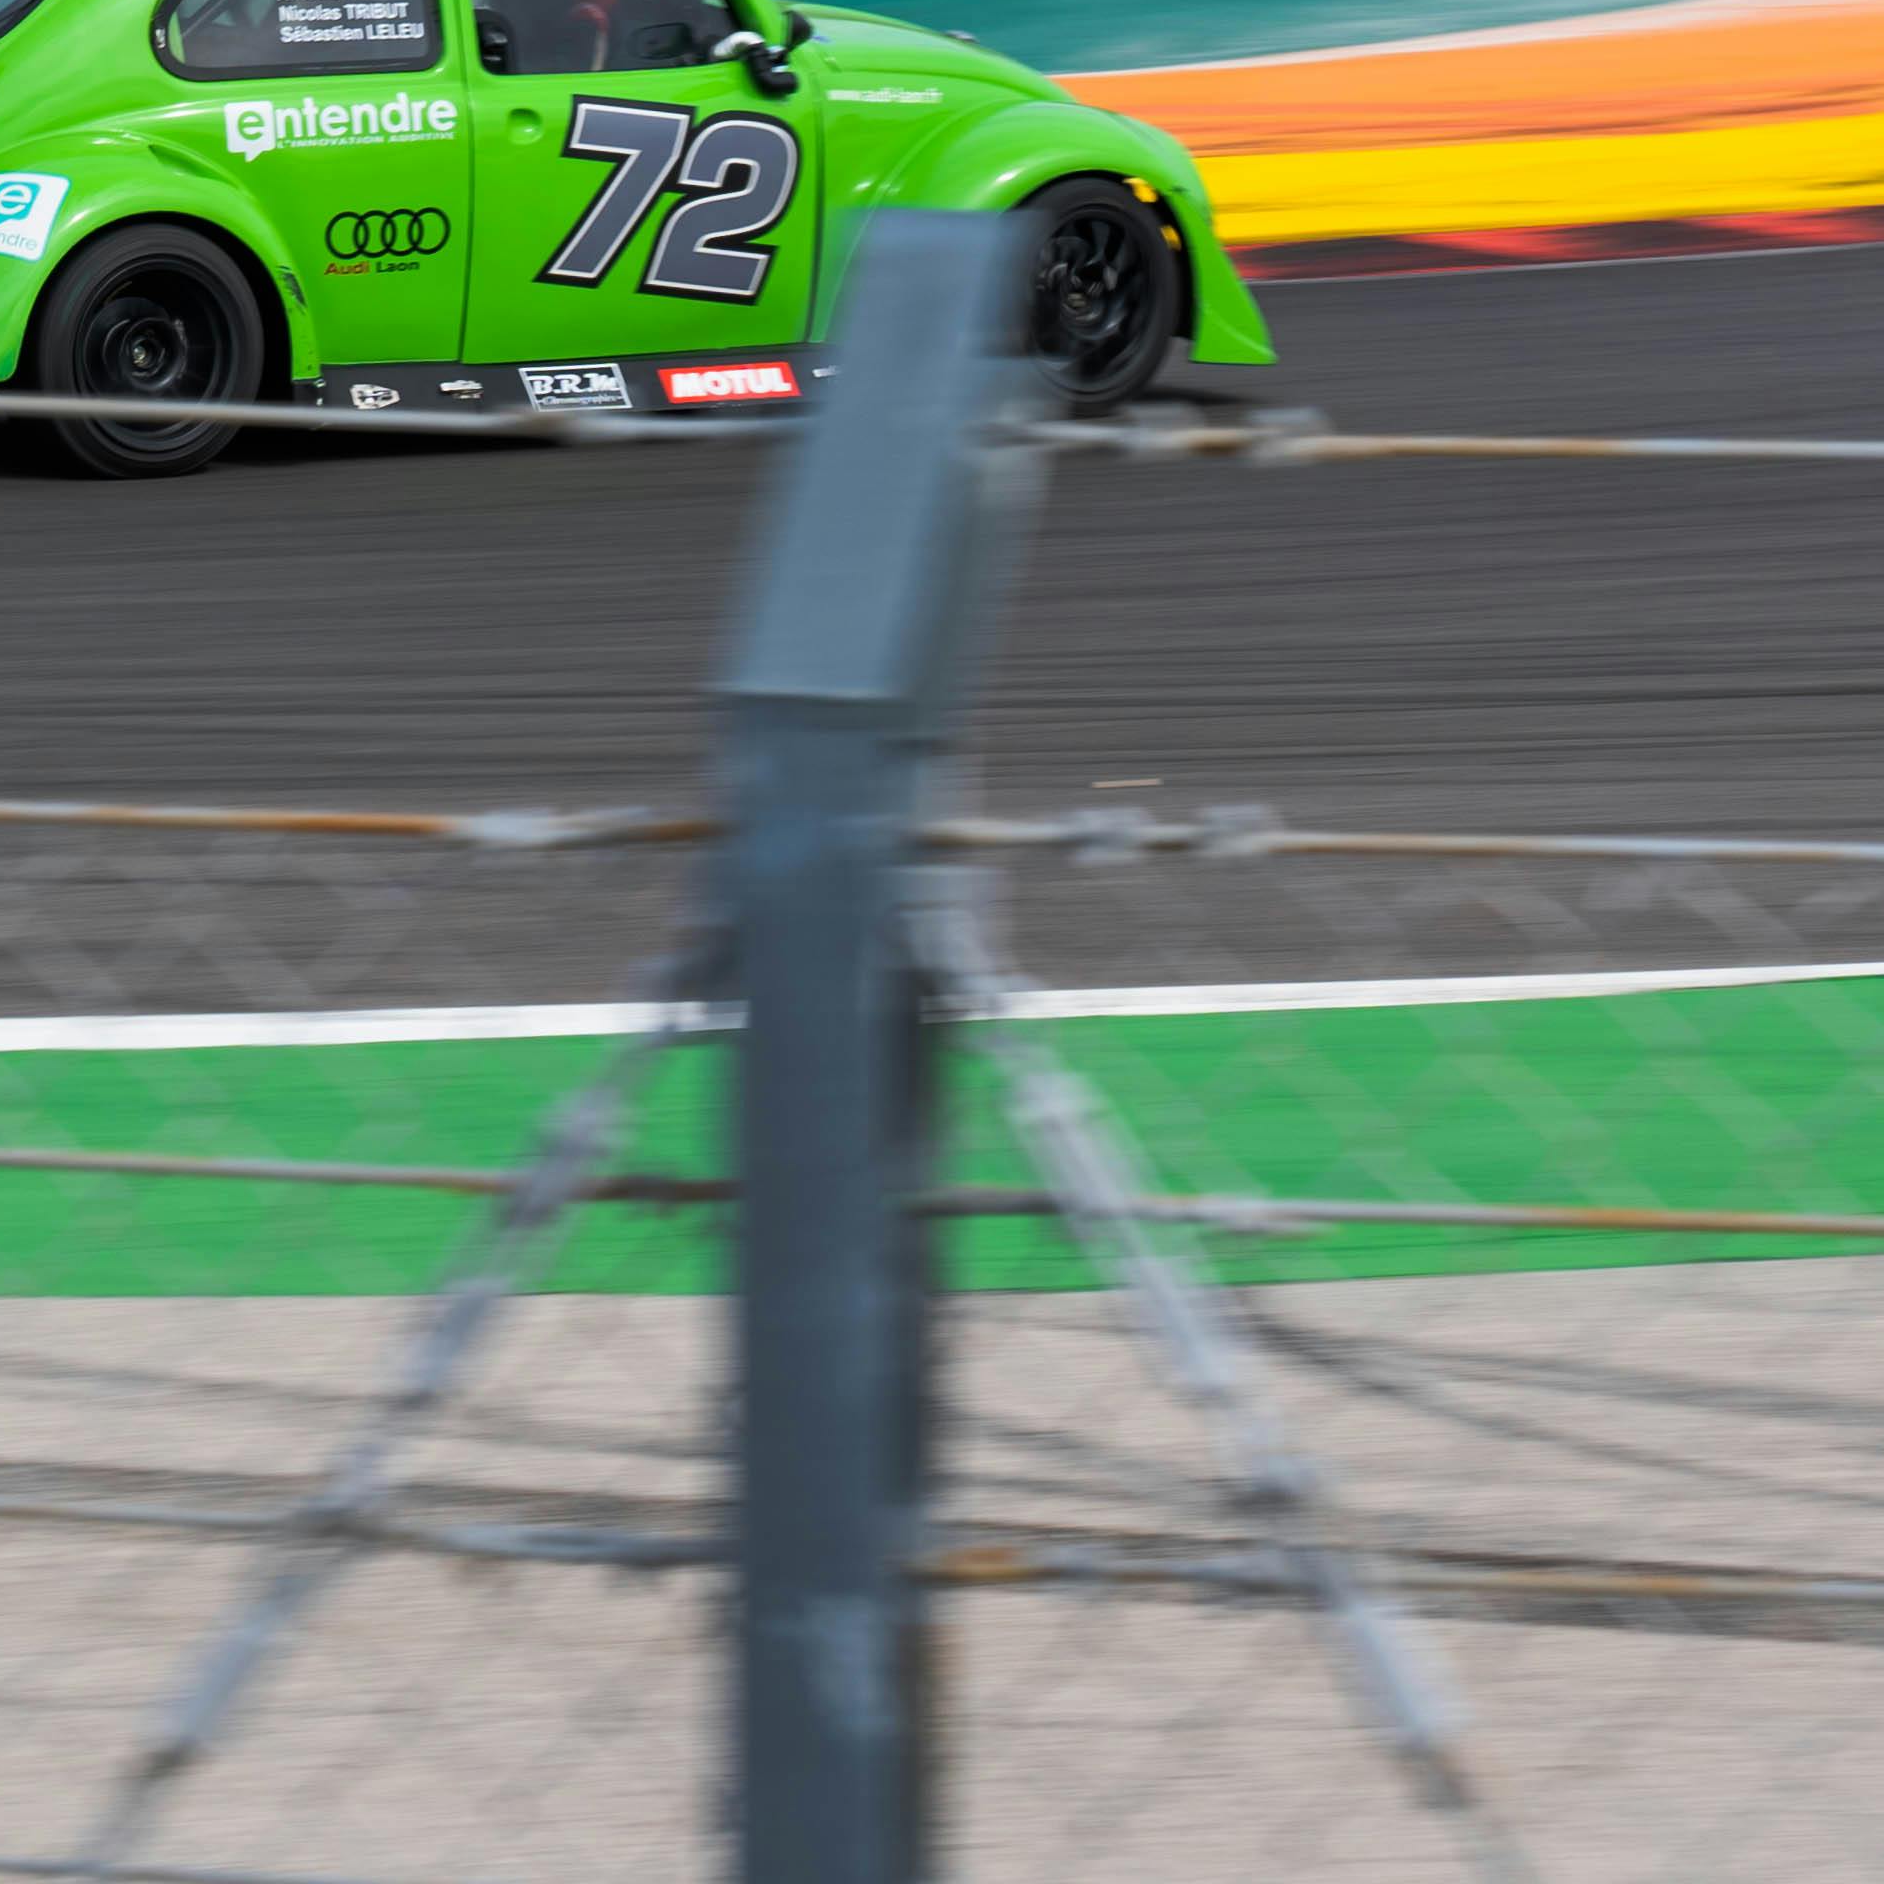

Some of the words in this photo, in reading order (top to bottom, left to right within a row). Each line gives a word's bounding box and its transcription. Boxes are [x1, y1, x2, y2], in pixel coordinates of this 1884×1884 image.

[278, 4, 342, 22] Nicolas
[343, 2, 409, 20] TRIBUT
[366, 22, 424, 40] LELEU
[228, 92, 458, 146] entendre
[533, 94, 801, 306] 72
[324, 261, 371, 275] Audi
[376, 261, 420, 273] Laon
[670, 367, 792, 398] MOTUL
